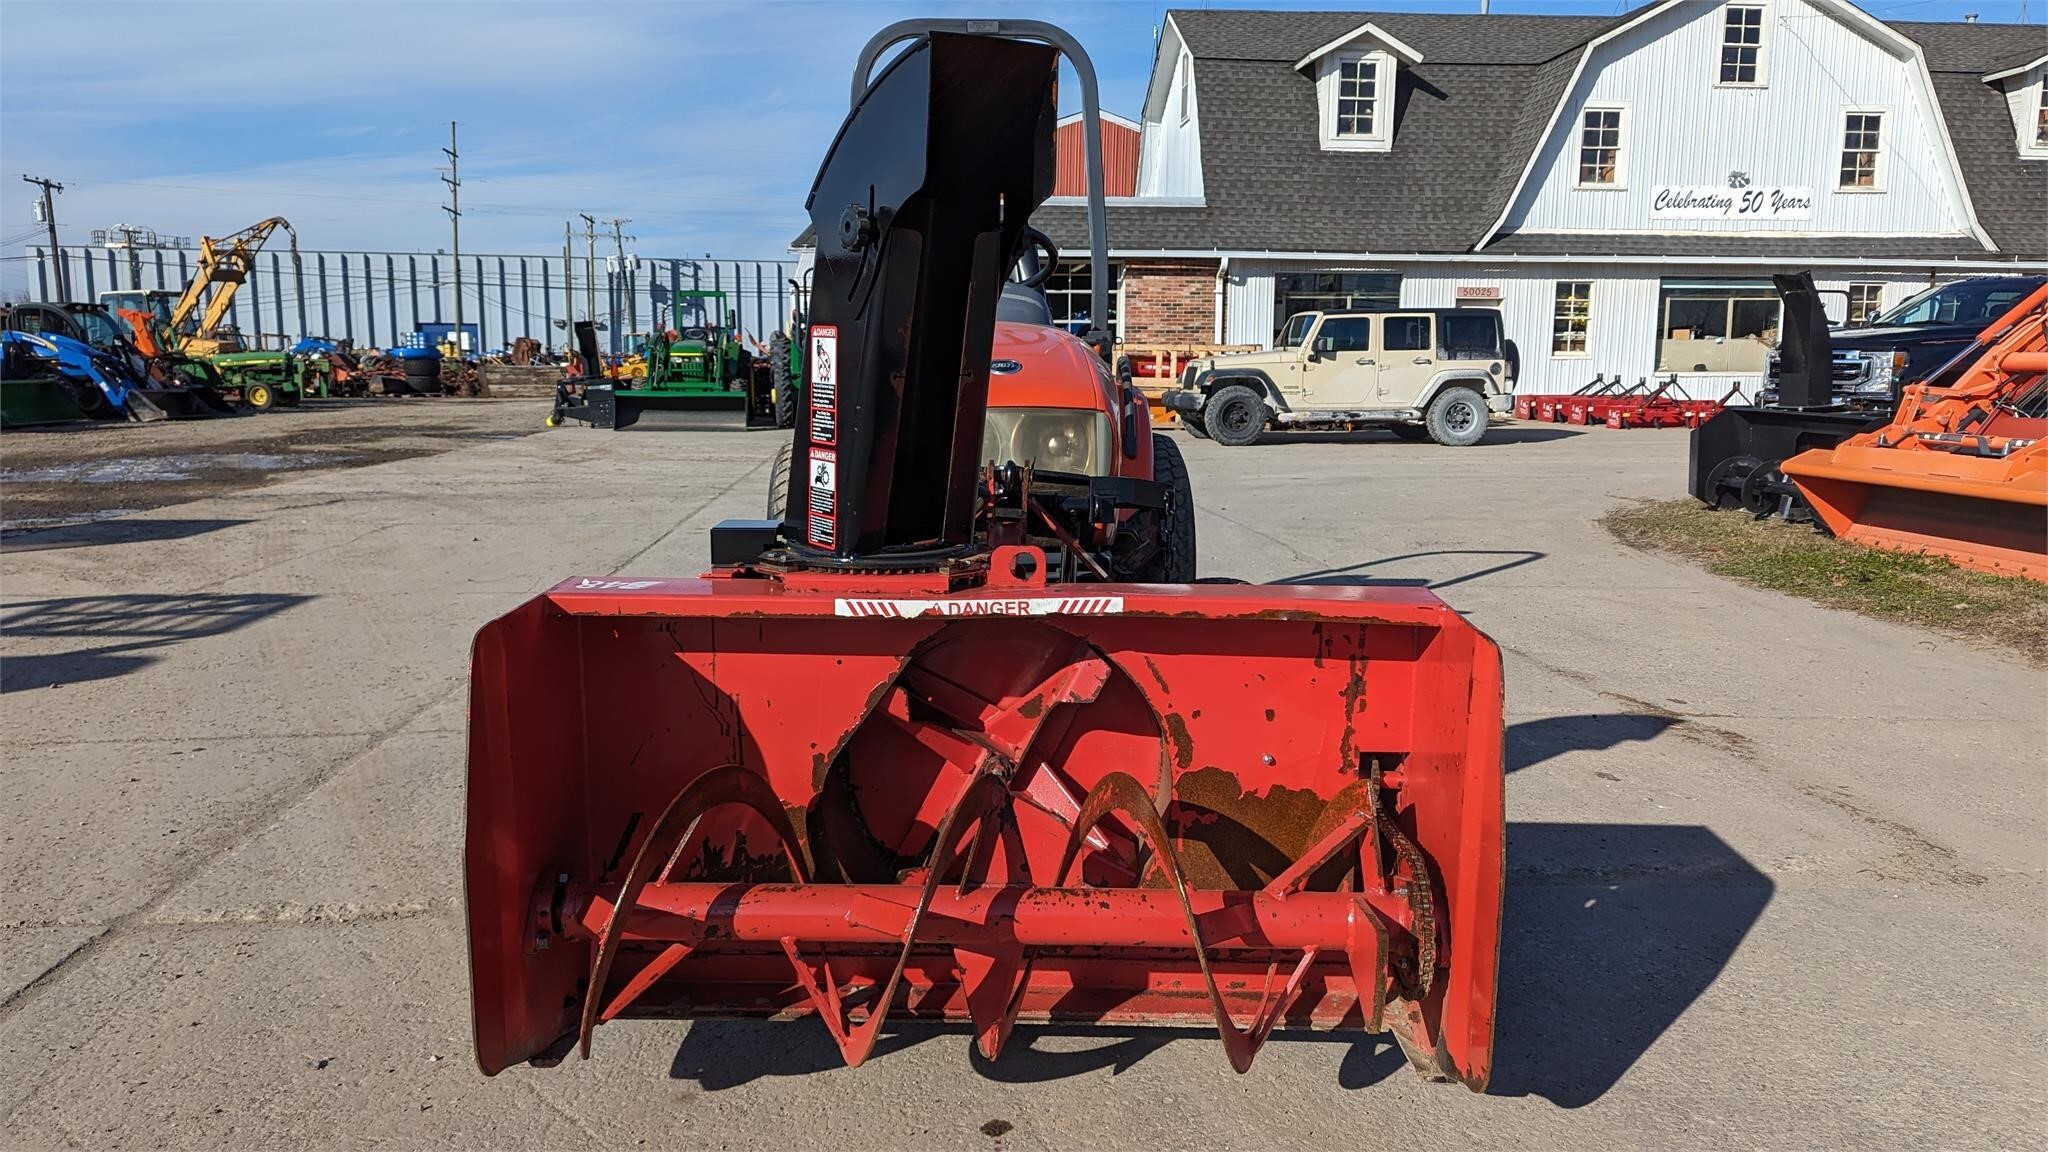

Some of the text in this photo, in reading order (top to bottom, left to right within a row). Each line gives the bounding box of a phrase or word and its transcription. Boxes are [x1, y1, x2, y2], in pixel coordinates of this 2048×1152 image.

[1654, 188, 1812, 215] Celebrating 50 Years
[1463, 287, 1492, 296] 50025
[816, 328, 836, 337] DANGER
[815, 450, 835, 461] DANGER
[950, 601, 1030, 615] DANGER
